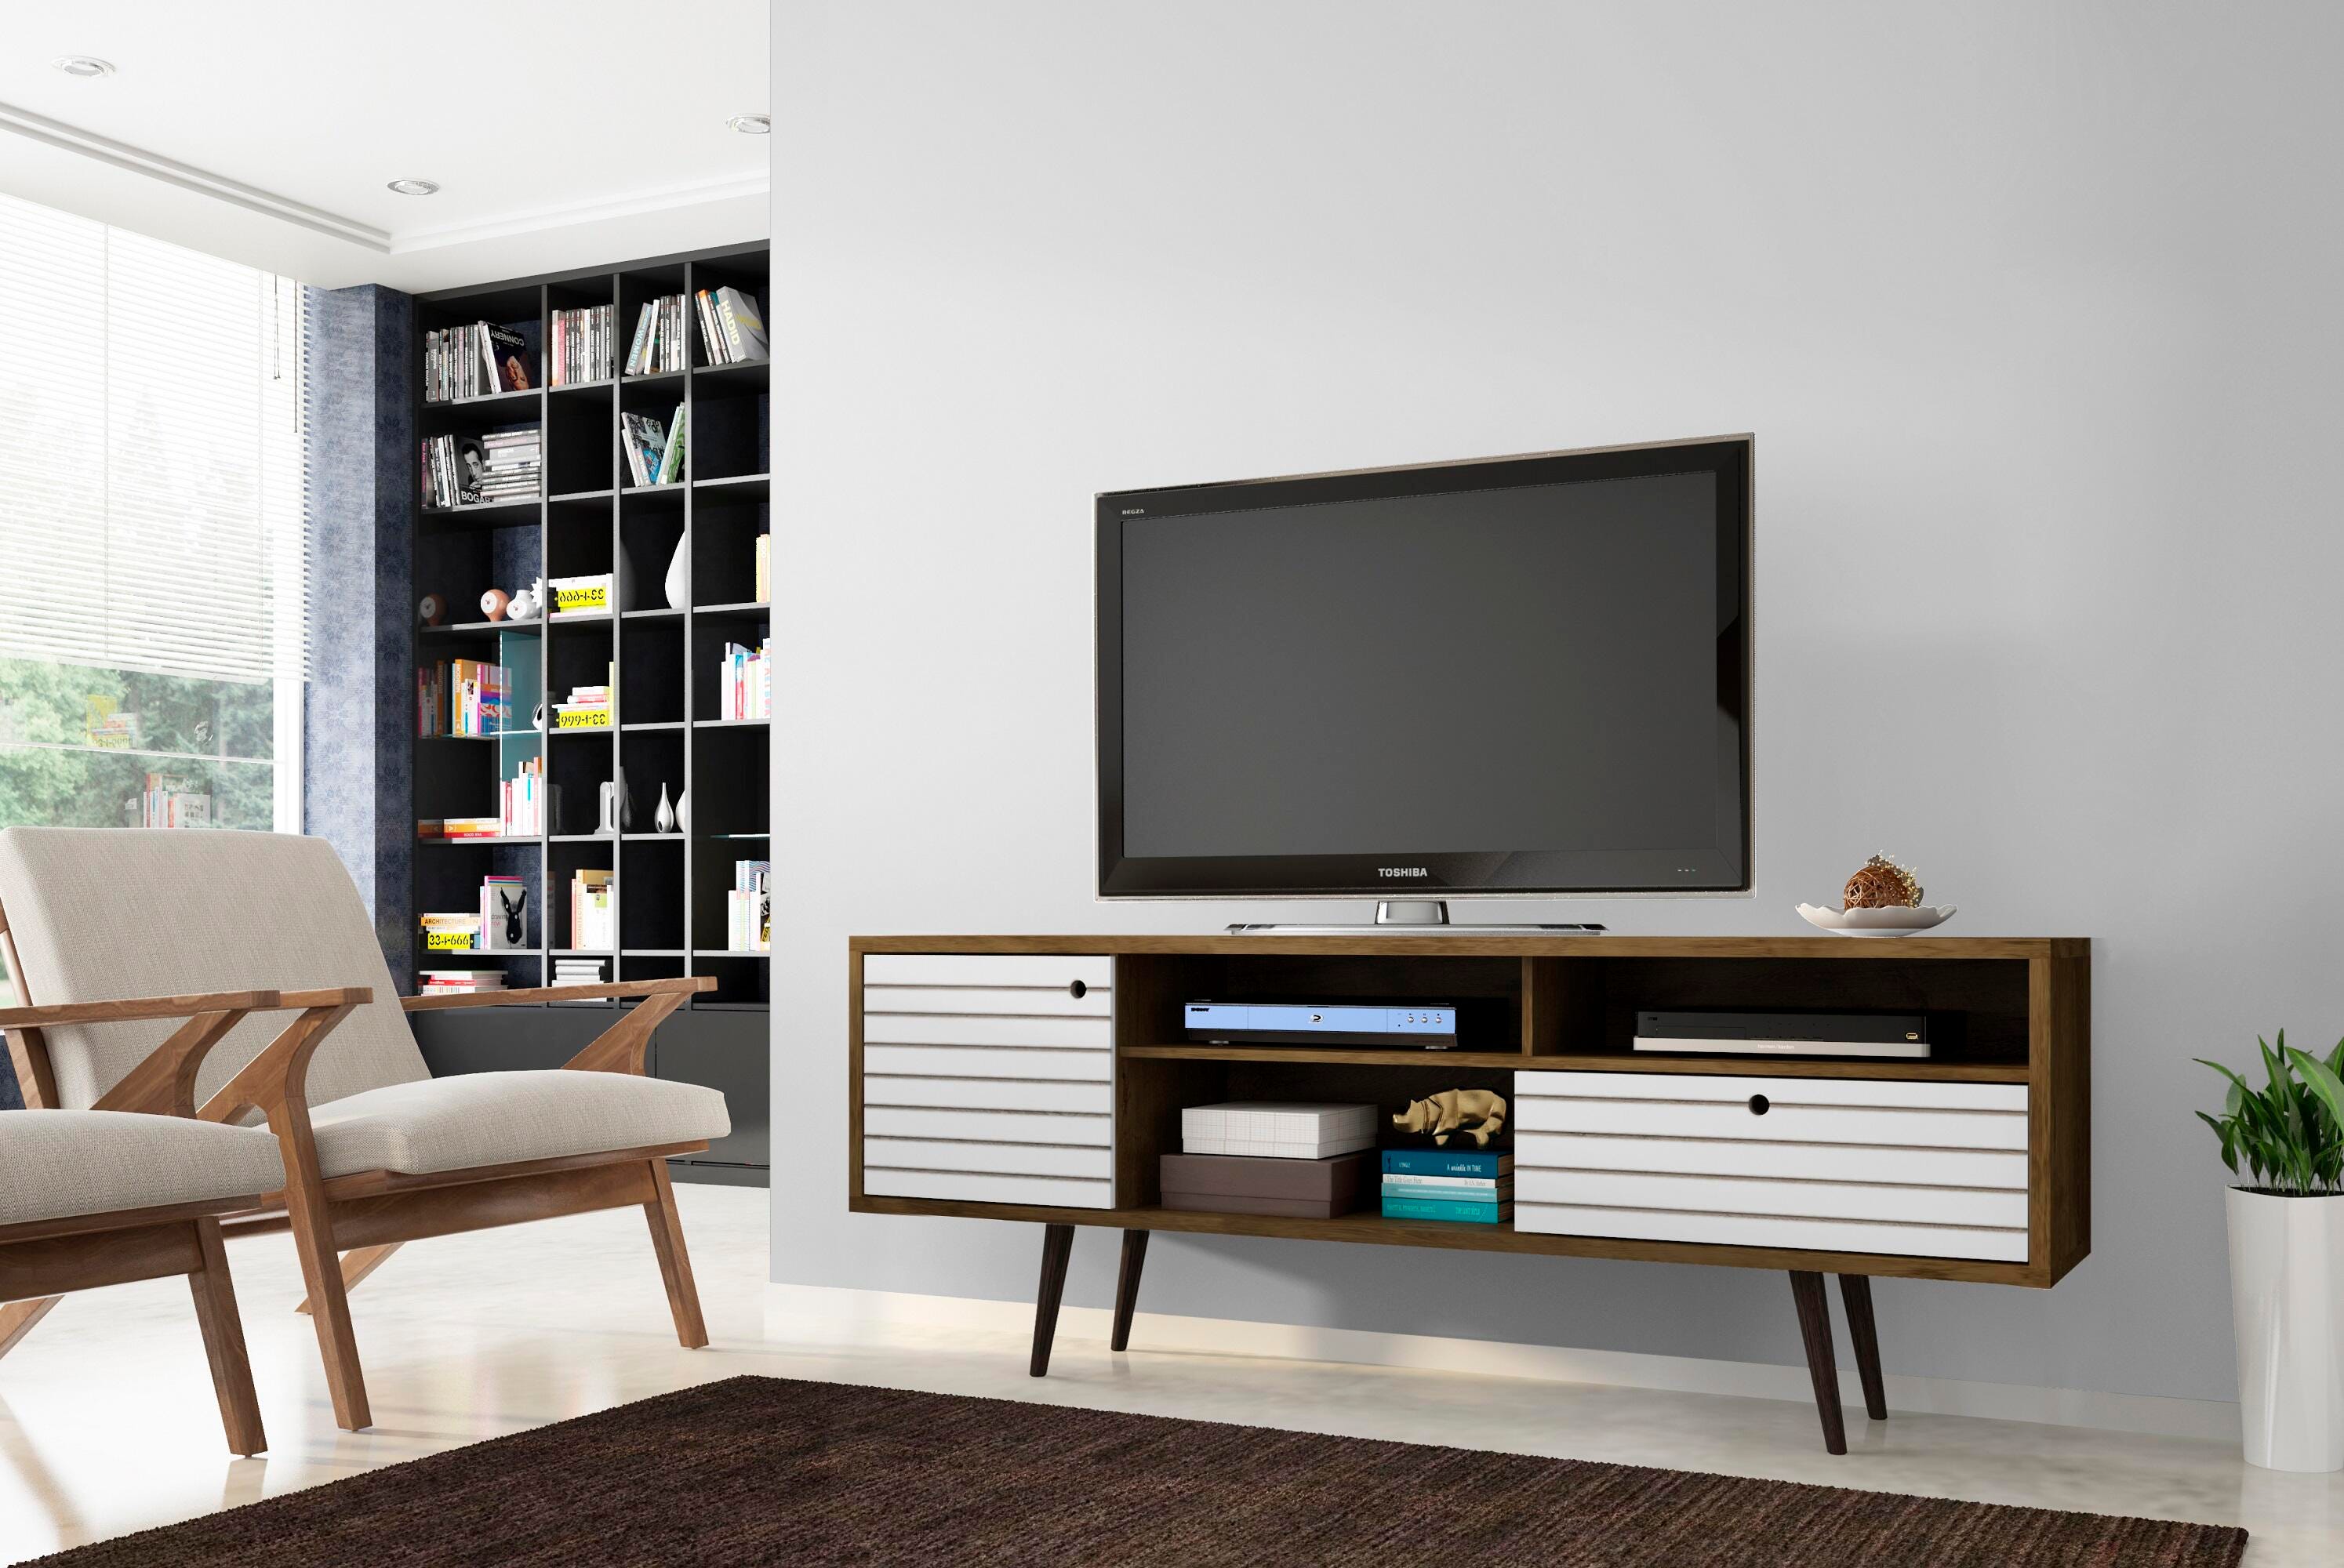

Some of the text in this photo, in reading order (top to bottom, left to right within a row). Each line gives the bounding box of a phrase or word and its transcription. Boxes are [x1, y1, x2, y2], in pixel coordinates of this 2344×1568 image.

[721, 299, 740, 346] HADID
[490, 329, 525, 347] CONNERY
[628, 328, 645, 367] WOMEN
[461, 491, 490, 503] BOGAR
[1378, 868, 1427, 877] TOSHIBA
